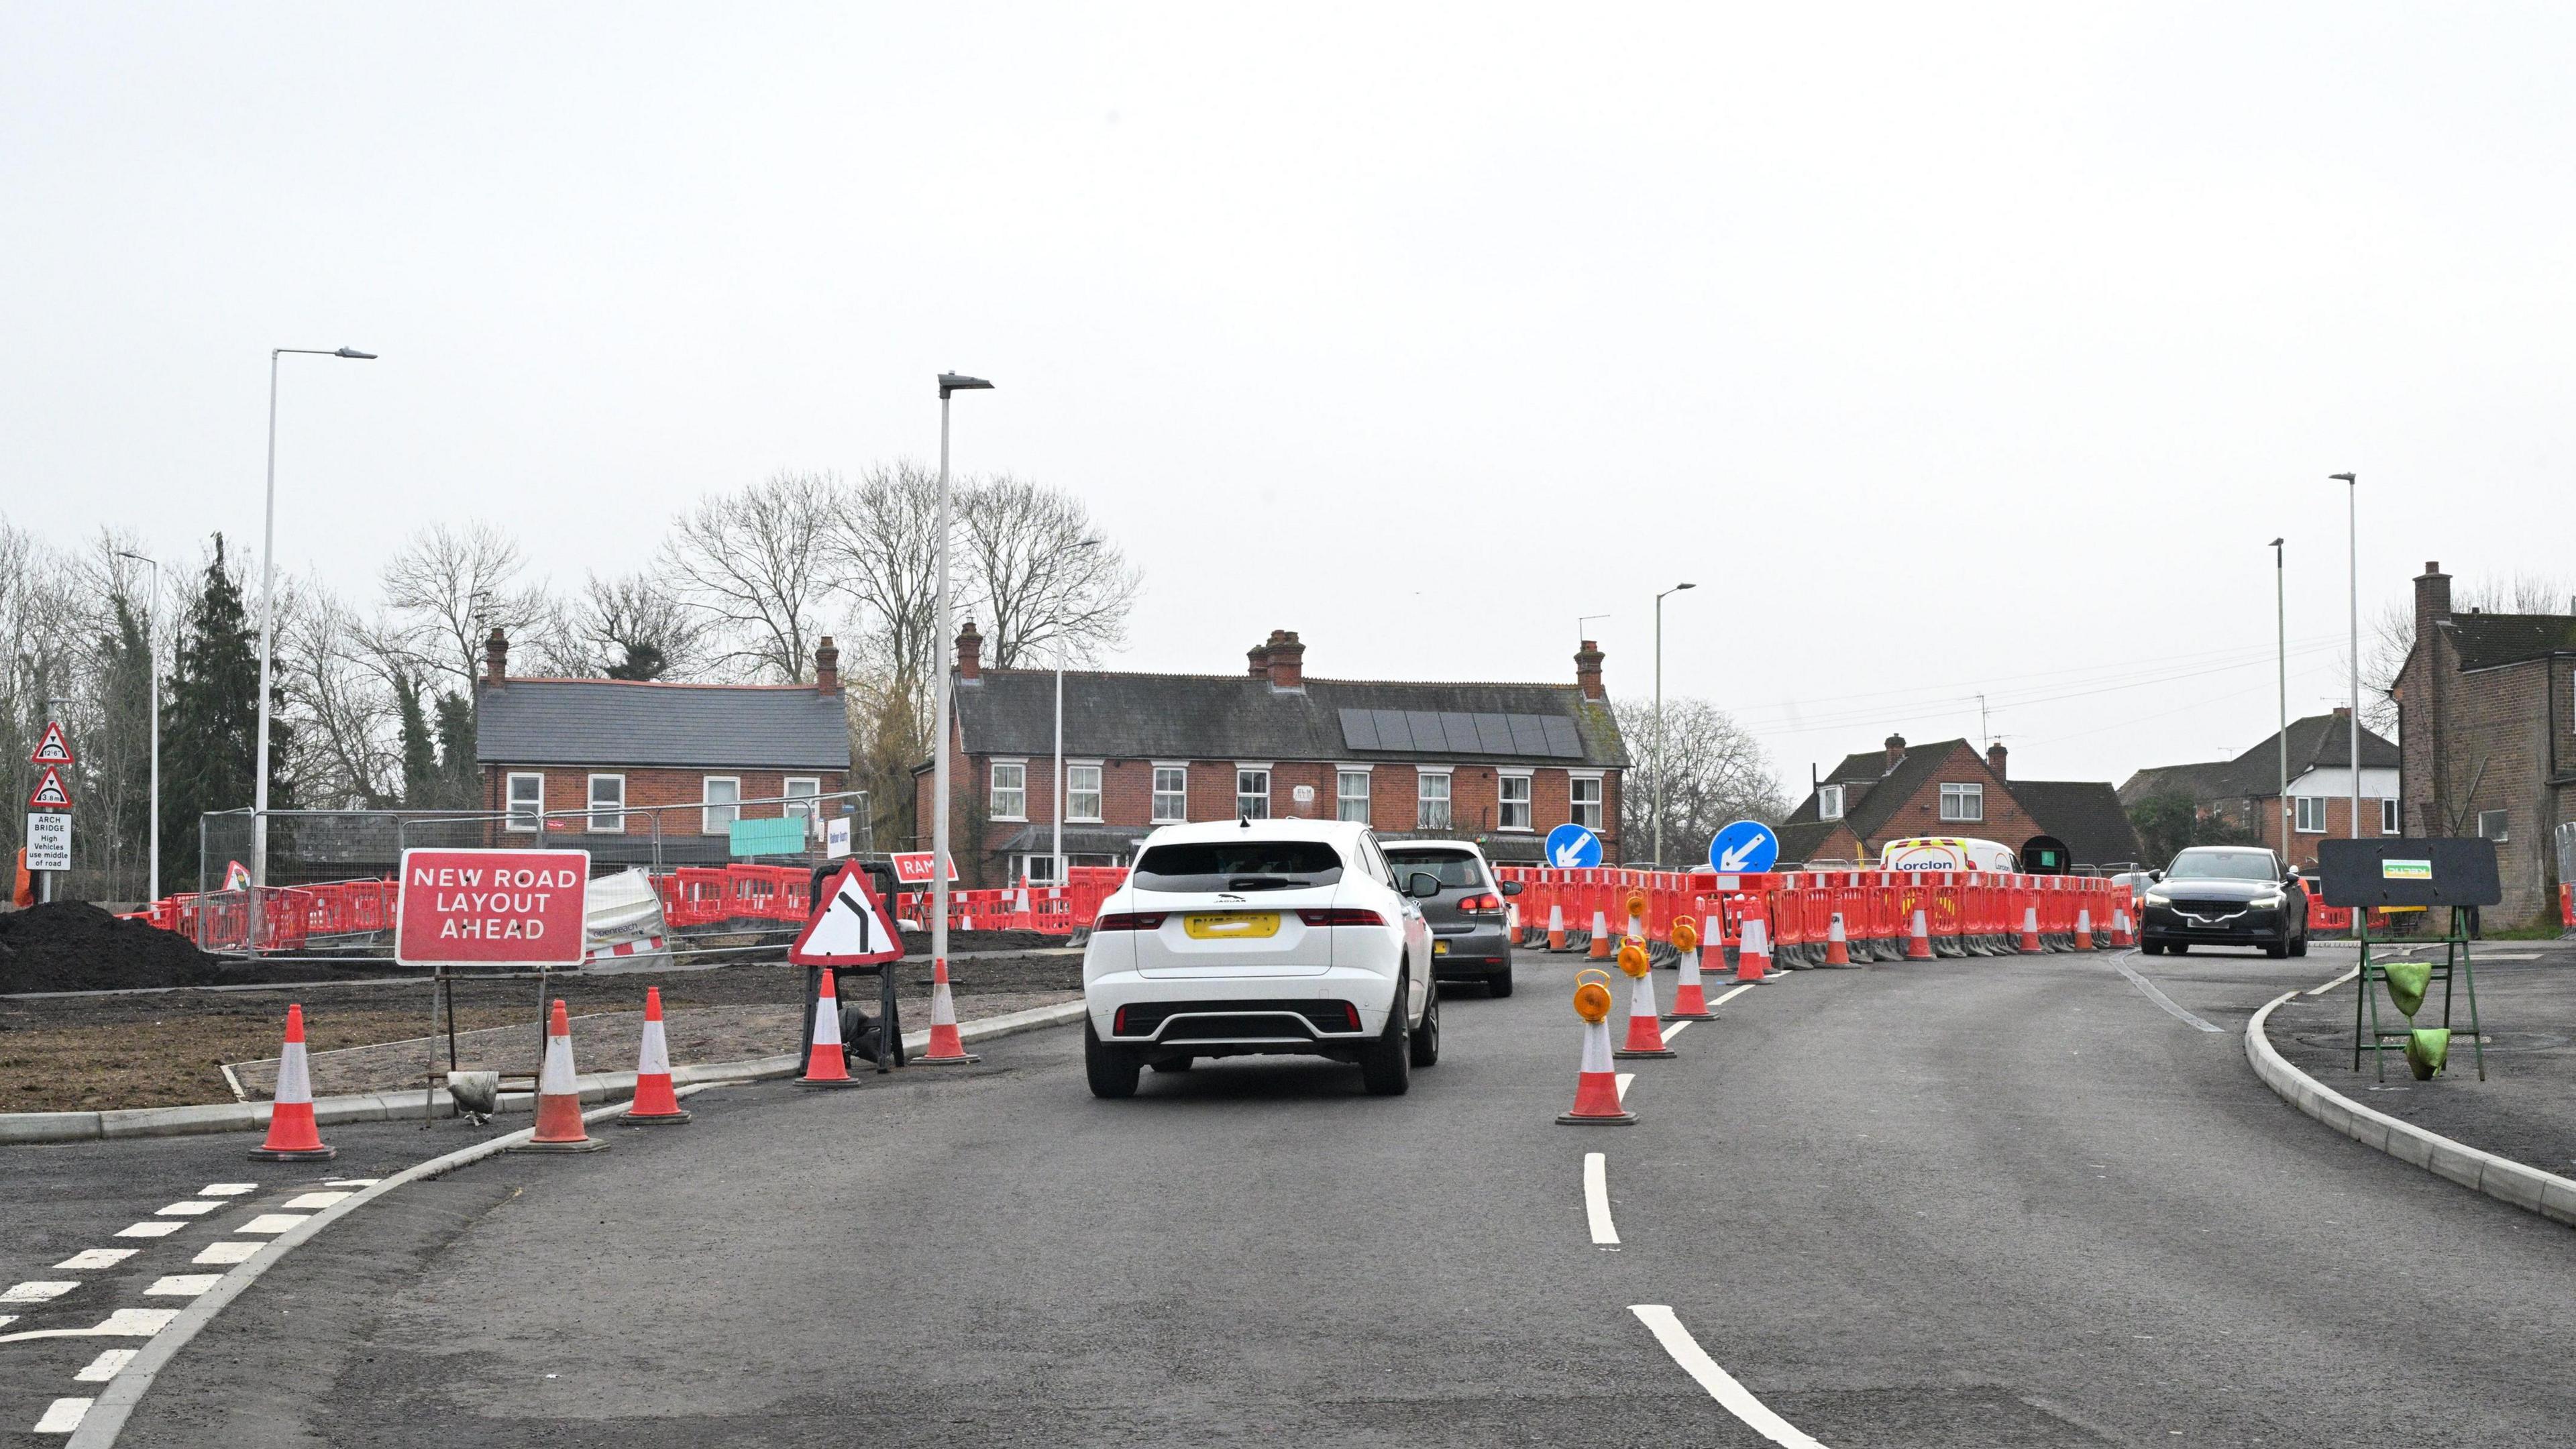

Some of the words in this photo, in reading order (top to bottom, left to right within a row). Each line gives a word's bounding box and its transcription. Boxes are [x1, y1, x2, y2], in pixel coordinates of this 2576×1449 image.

[904, 859, 934, 874] RAM
[413, 868, 483, 887] NEW
[494, 869, 577, 888] ROAD
[436, 892, 551, 913] LAYOUT
[440, 918, 545, 939] AHEAD
[593, 922, 638, 938] openreach
